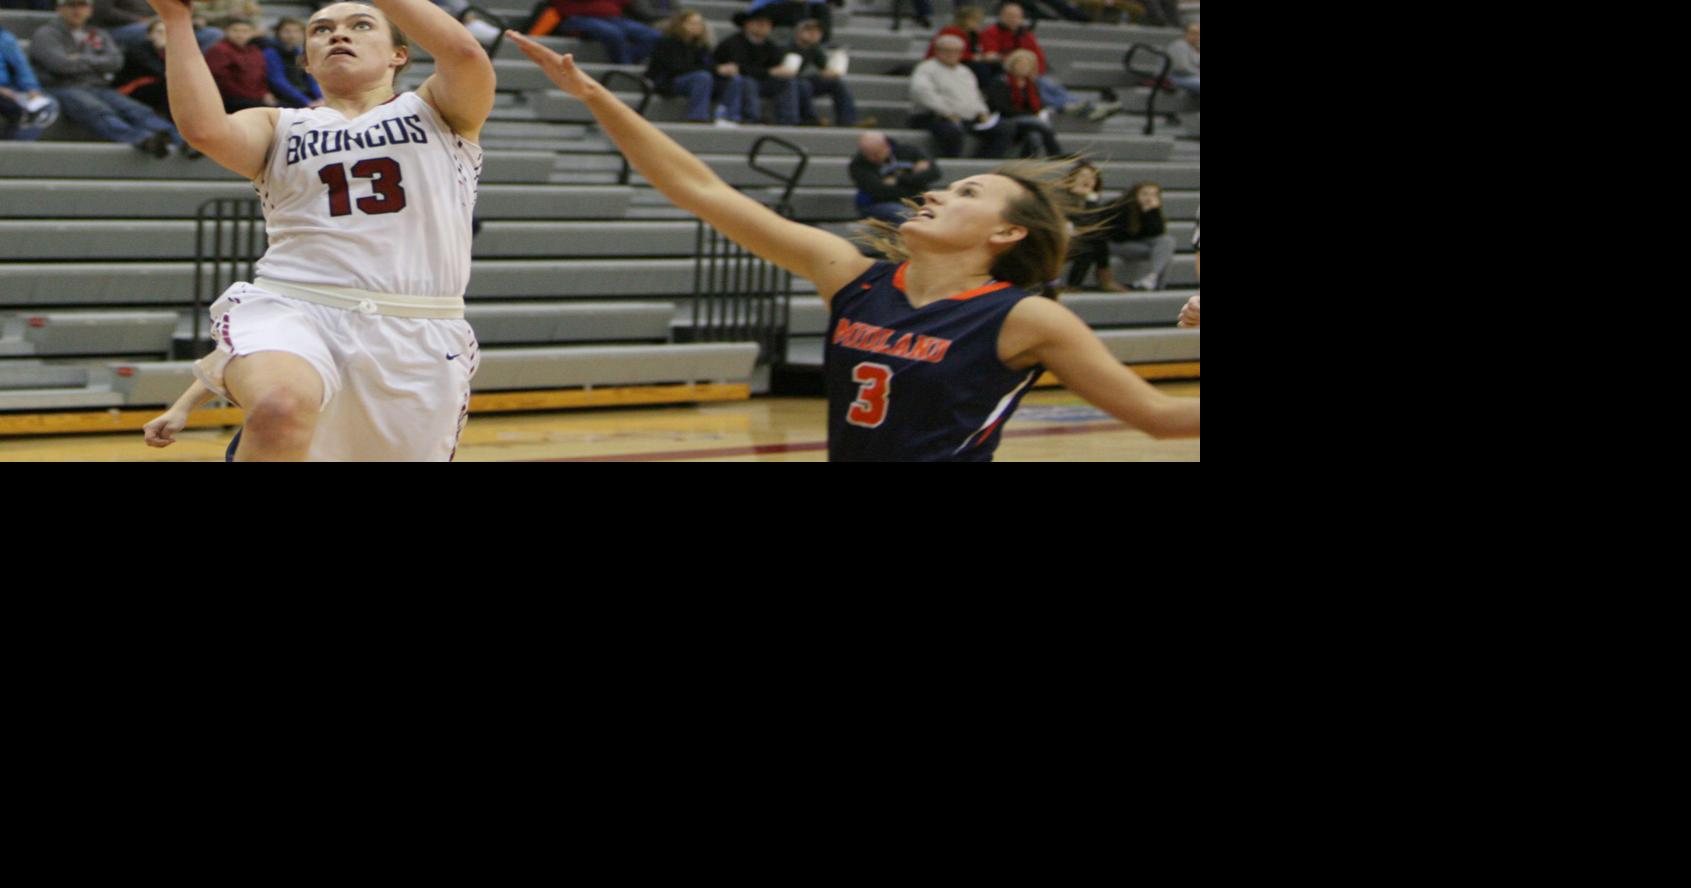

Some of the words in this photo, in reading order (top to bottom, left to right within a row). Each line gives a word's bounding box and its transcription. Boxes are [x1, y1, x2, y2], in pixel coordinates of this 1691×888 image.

[287, 114, 428, 166] BRONCOS
[318, 157, 407, 217] 13
[832, 318, 953, 363] MIDLAND
[846, 361, 894, 429] 3
